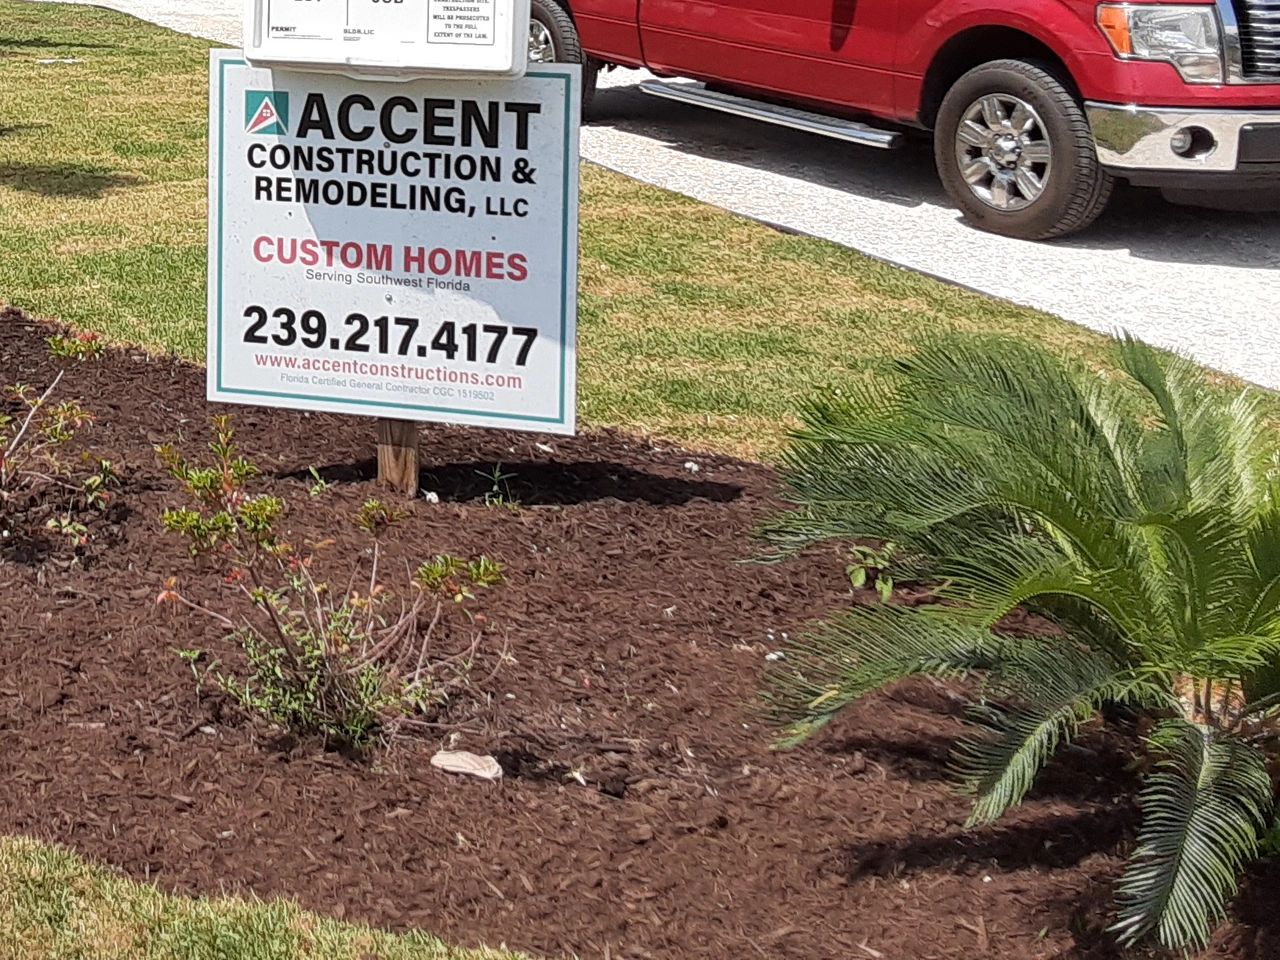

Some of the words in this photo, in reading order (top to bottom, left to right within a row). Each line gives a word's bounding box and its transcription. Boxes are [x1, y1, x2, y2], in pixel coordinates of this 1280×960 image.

[296, 92, 542, 151] ACCENT
[247, 143, 501, 182] CONSTRUCTION
[512, 158, 537, 185] &
[254, 176, 476, 218] REMODELING,
[485, 196, 529, 218] LLC
[253, 235, 392, 272] CUSTOM
[403, 245, 528, 282] HOMES
[306, 269, 353, 285] Serving
[356, 272, 423, 288] Southwest
[427, 277, 470, 291] Florida
[242, 305, 539, 367] 239.217.4177
[255, 353, 522, 389] www.accentconstructions.com
[280, 372, 309, 384] Florida
[311, 375, 347, 387] Certified
[349, 379, 383, 390] General
[385, 382, 430, 394] Contractor
[432, 386, 454, 397] CGC
